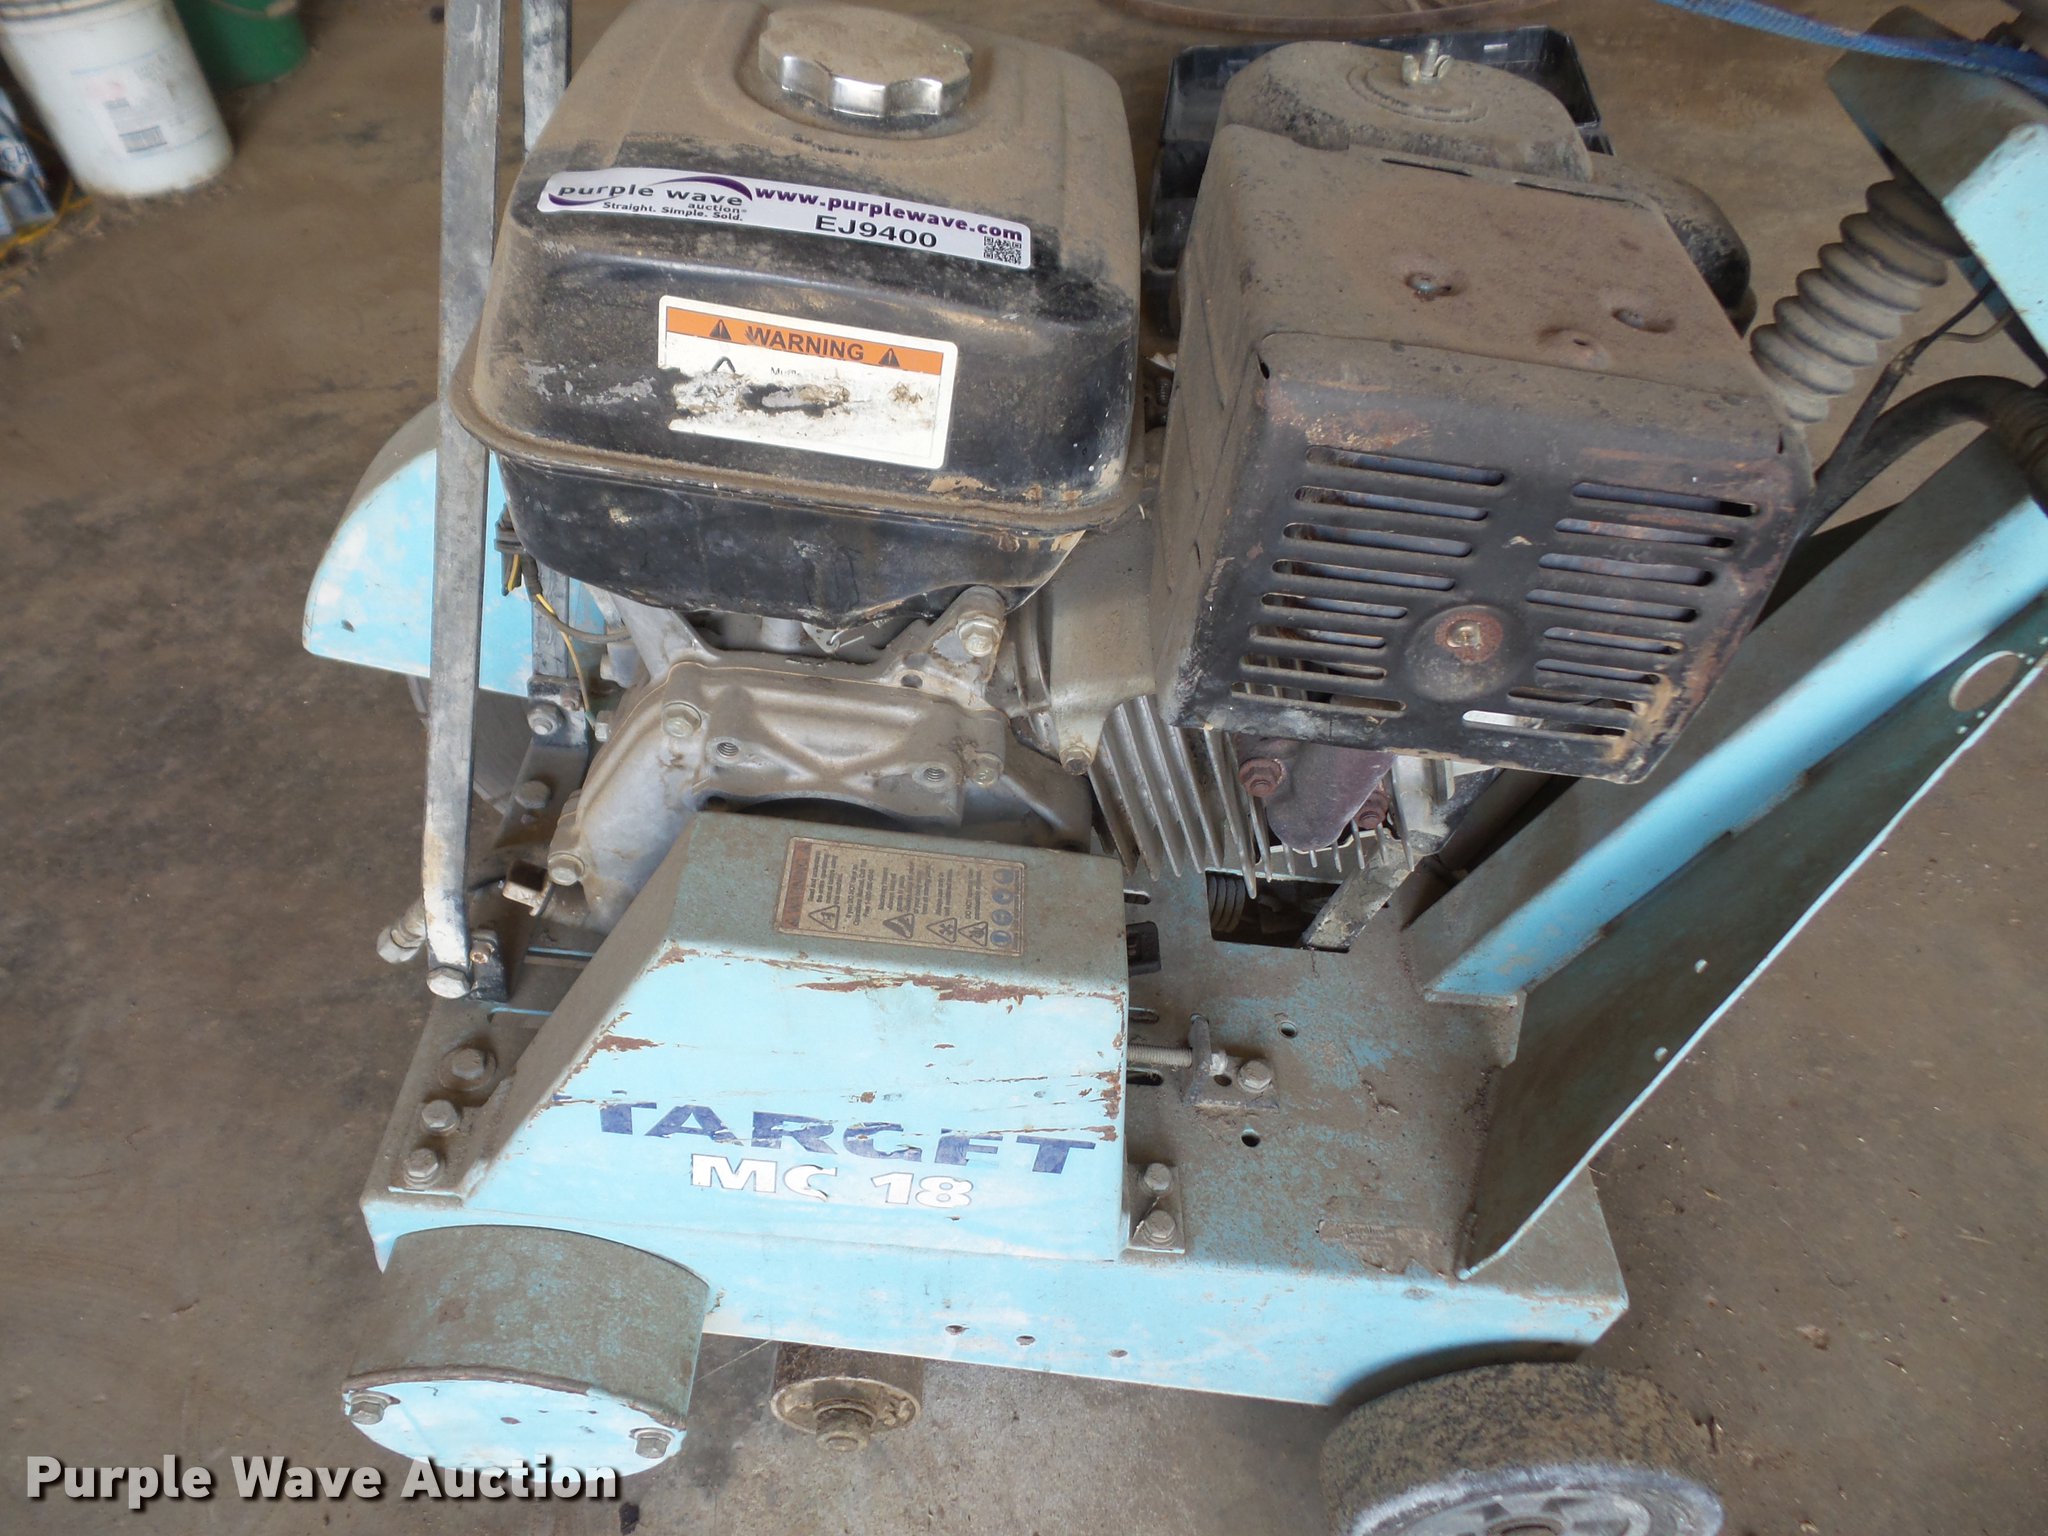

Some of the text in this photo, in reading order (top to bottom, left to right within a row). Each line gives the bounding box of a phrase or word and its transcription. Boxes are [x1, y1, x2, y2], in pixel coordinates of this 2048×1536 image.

[558, 183, 743, 206] purple wave
[603, 201, 743, 221] Straight. Simple. Sold.
[688, 203, 740, 213] auction
[755, 187, 1023, 241] www.purplewave.com
[815, 214, 938, 248] EJ9400
[744, 325, 864, 361] WARNING
[690, 1153, 973, 1208] MC 18
